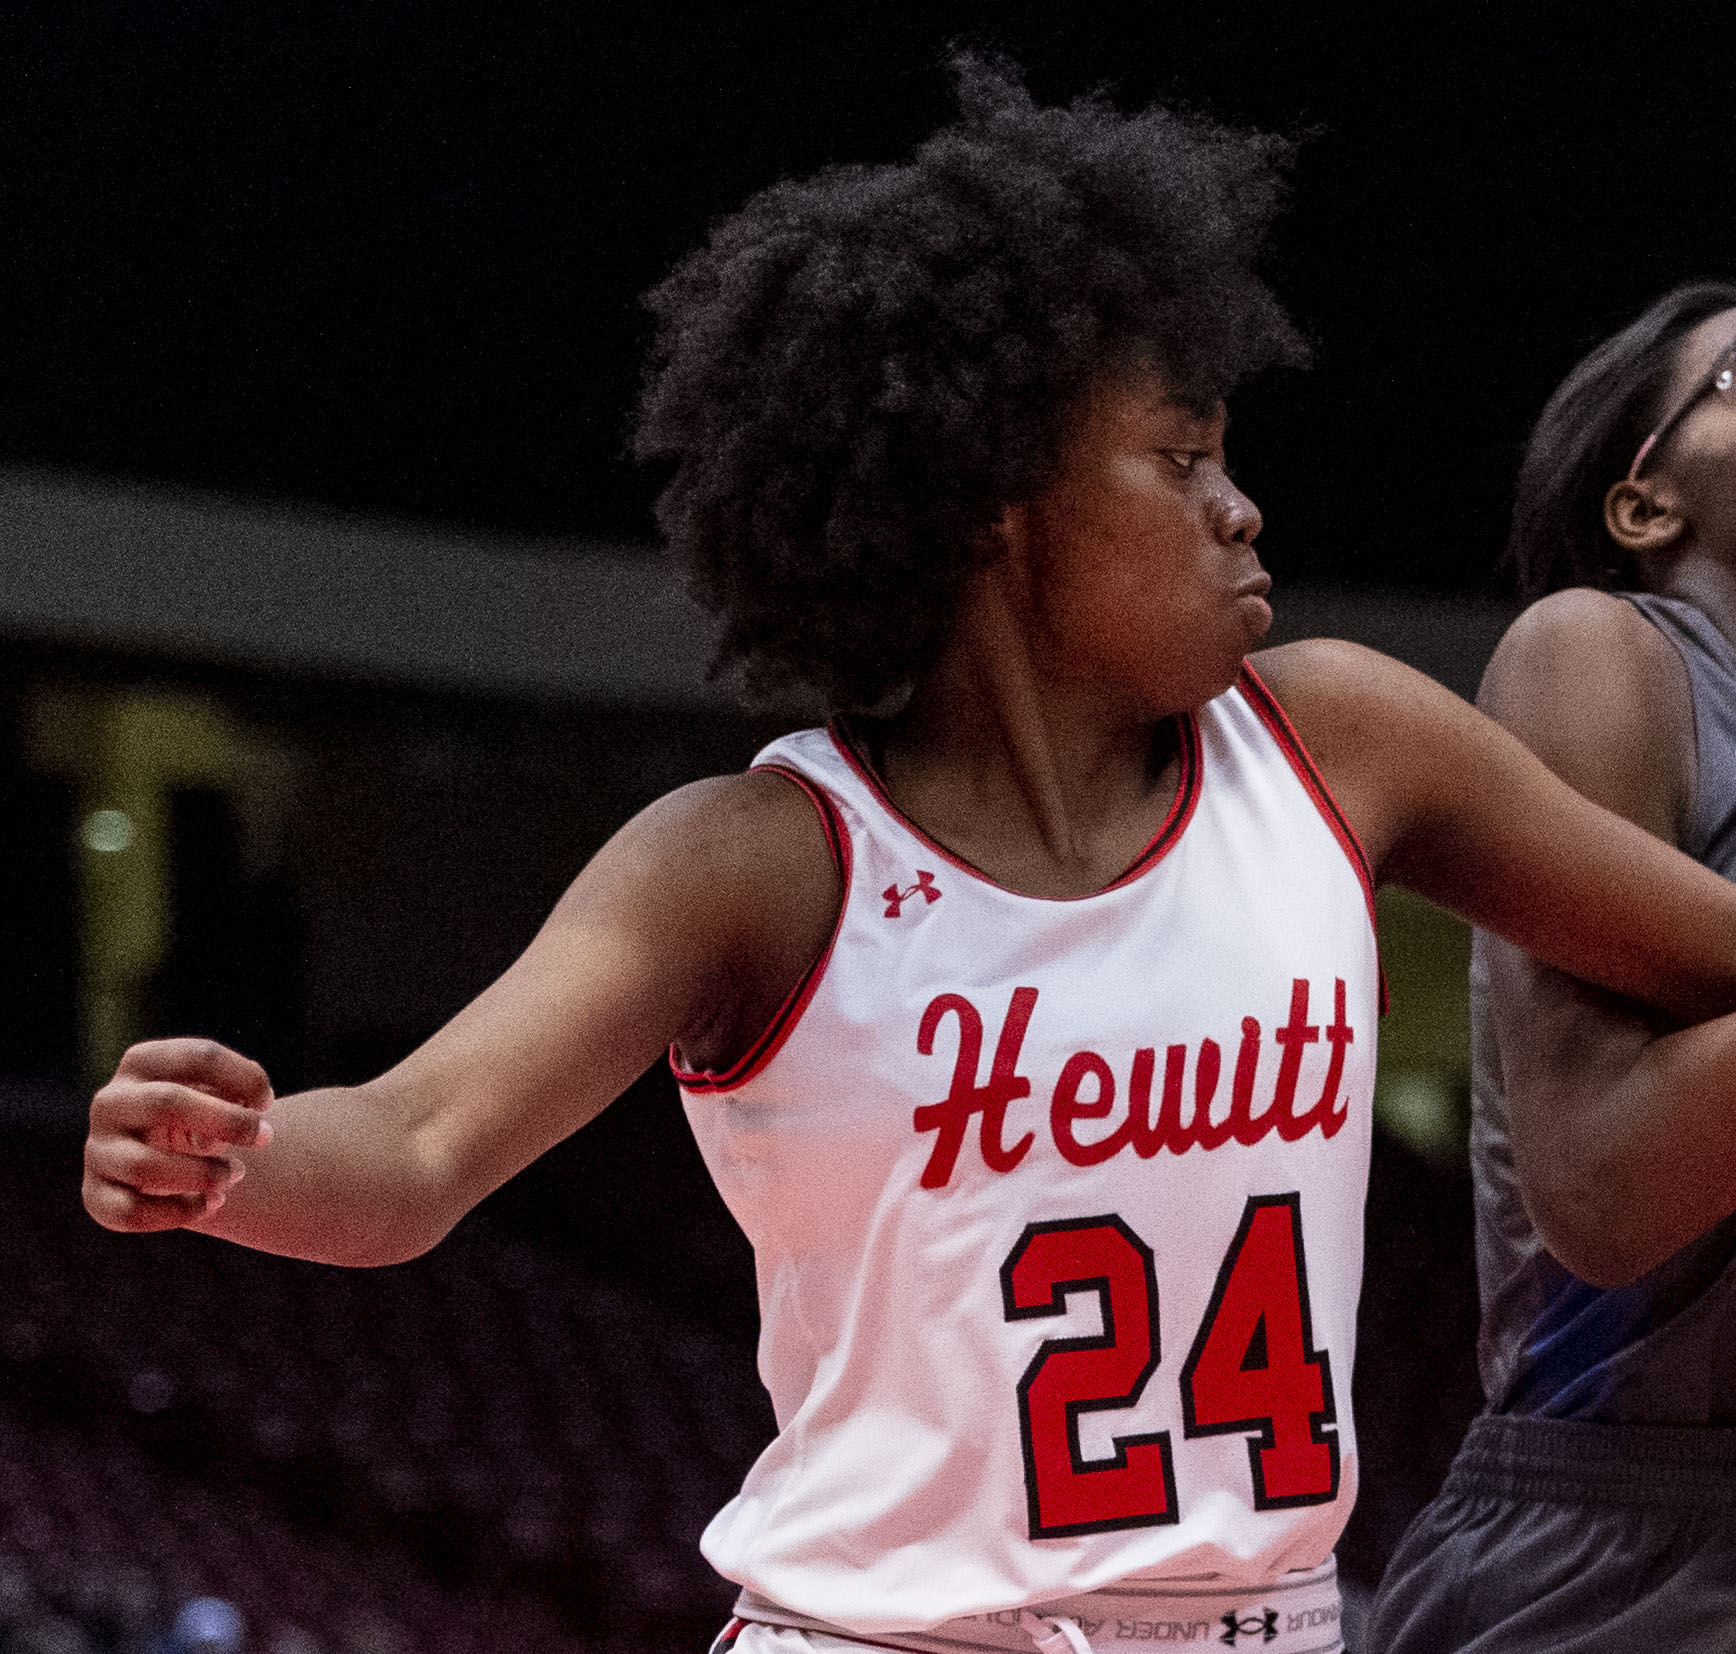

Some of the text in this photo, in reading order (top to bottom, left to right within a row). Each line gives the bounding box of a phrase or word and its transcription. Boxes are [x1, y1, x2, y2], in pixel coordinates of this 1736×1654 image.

[913, 976, 1355, 1190] Hewitt
[1000, 1191, 1340, 1541] 24
[1115, 1619, 1209, 1642] UNDER
